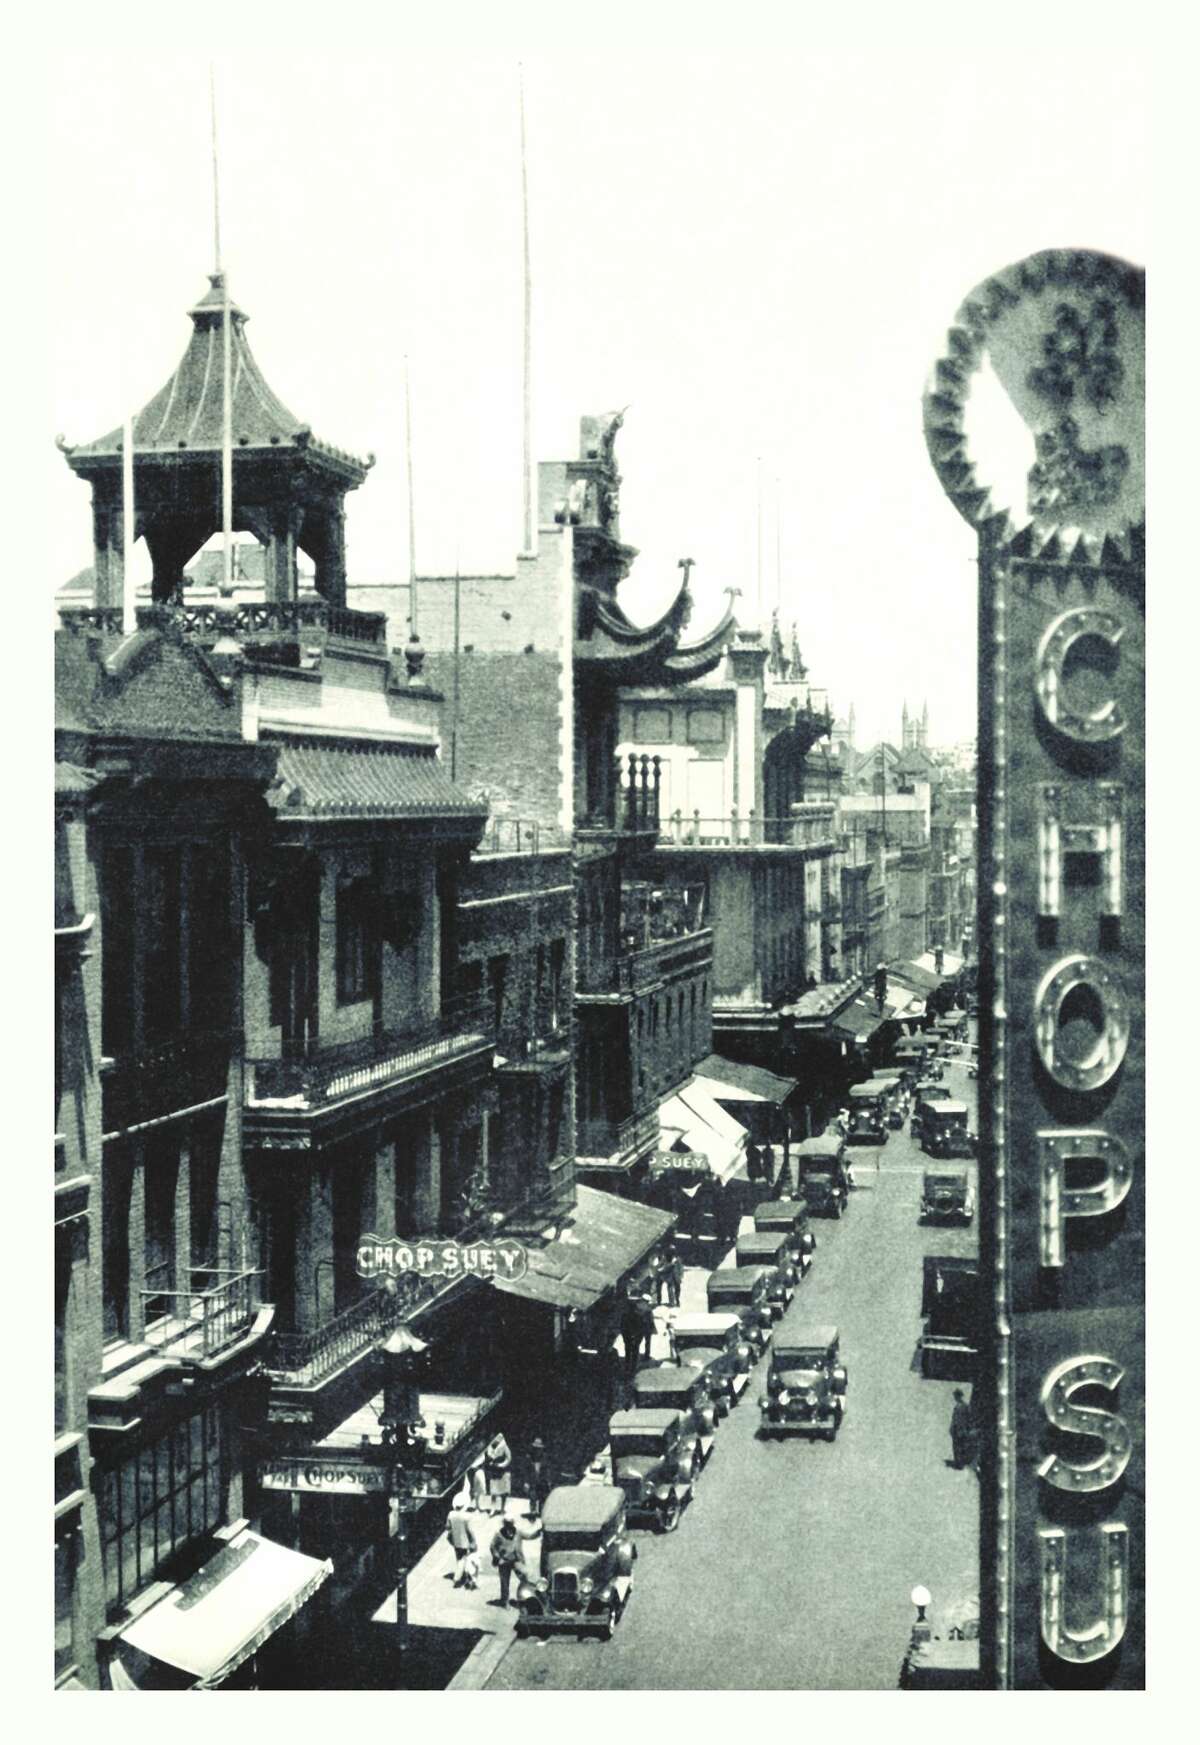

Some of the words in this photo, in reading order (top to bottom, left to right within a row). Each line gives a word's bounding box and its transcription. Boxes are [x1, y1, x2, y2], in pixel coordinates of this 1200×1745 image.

[1035, 605, 1134, 1268] CHOP
[662, 1156, 704, 1168] SUEY
[357, 1246, 434, 1269] CHOP
[442, 1248, 520, 1272] SUEY
[304, 1466, 345, 1487] CHOP
[1037, 1355, 1133, 1663] SU
